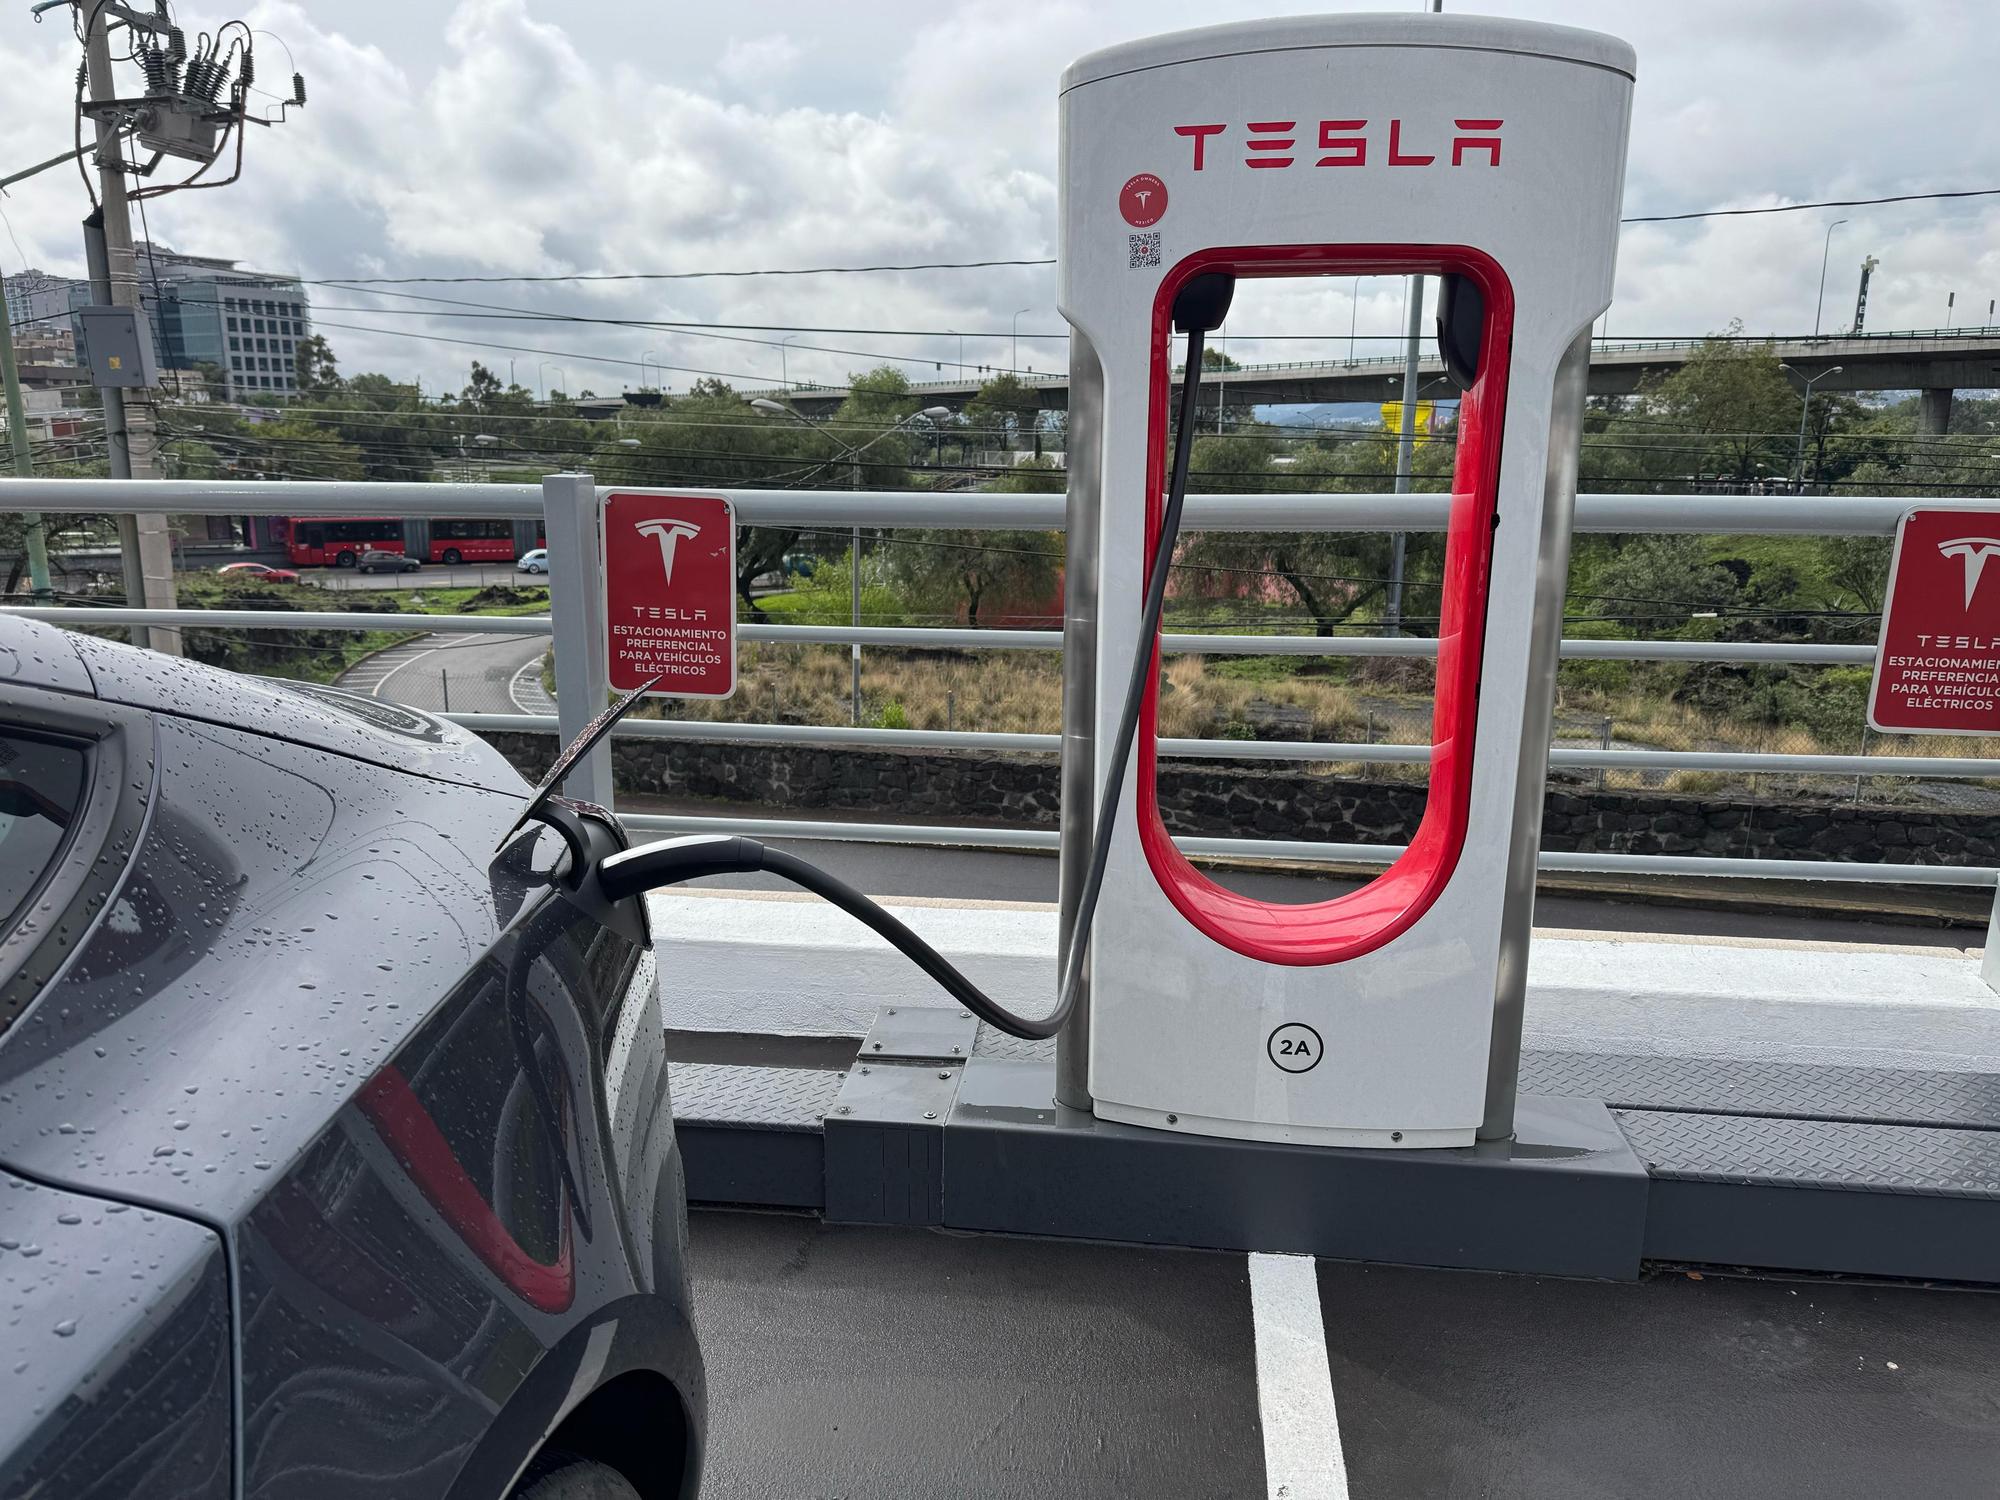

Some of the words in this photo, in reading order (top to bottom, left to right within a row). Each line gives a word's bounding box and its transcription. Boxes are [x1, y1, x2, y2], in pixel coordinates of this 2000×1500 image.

[1173, 119, 1505, 171] TESLA
[633, 606, 707, 621] TESLA
[613, 625, 727, 640] ESTACIONAMIENTO
[626, 638, 714, 652] PREFERENCIAL
[1917, 635, 2000, 650] TESLA
[620, 650, 652, 661] PARA
[655, 651, 721, 664] VEHÍCULOS
[634, 661, 706, 675] ELÉCTRICOS
[1891, 683, 1929, 695] PARA
[1906, 696, 1994, 711] ELÉCTRICOS
[1280, 1039, 1311, 1056] 2A
